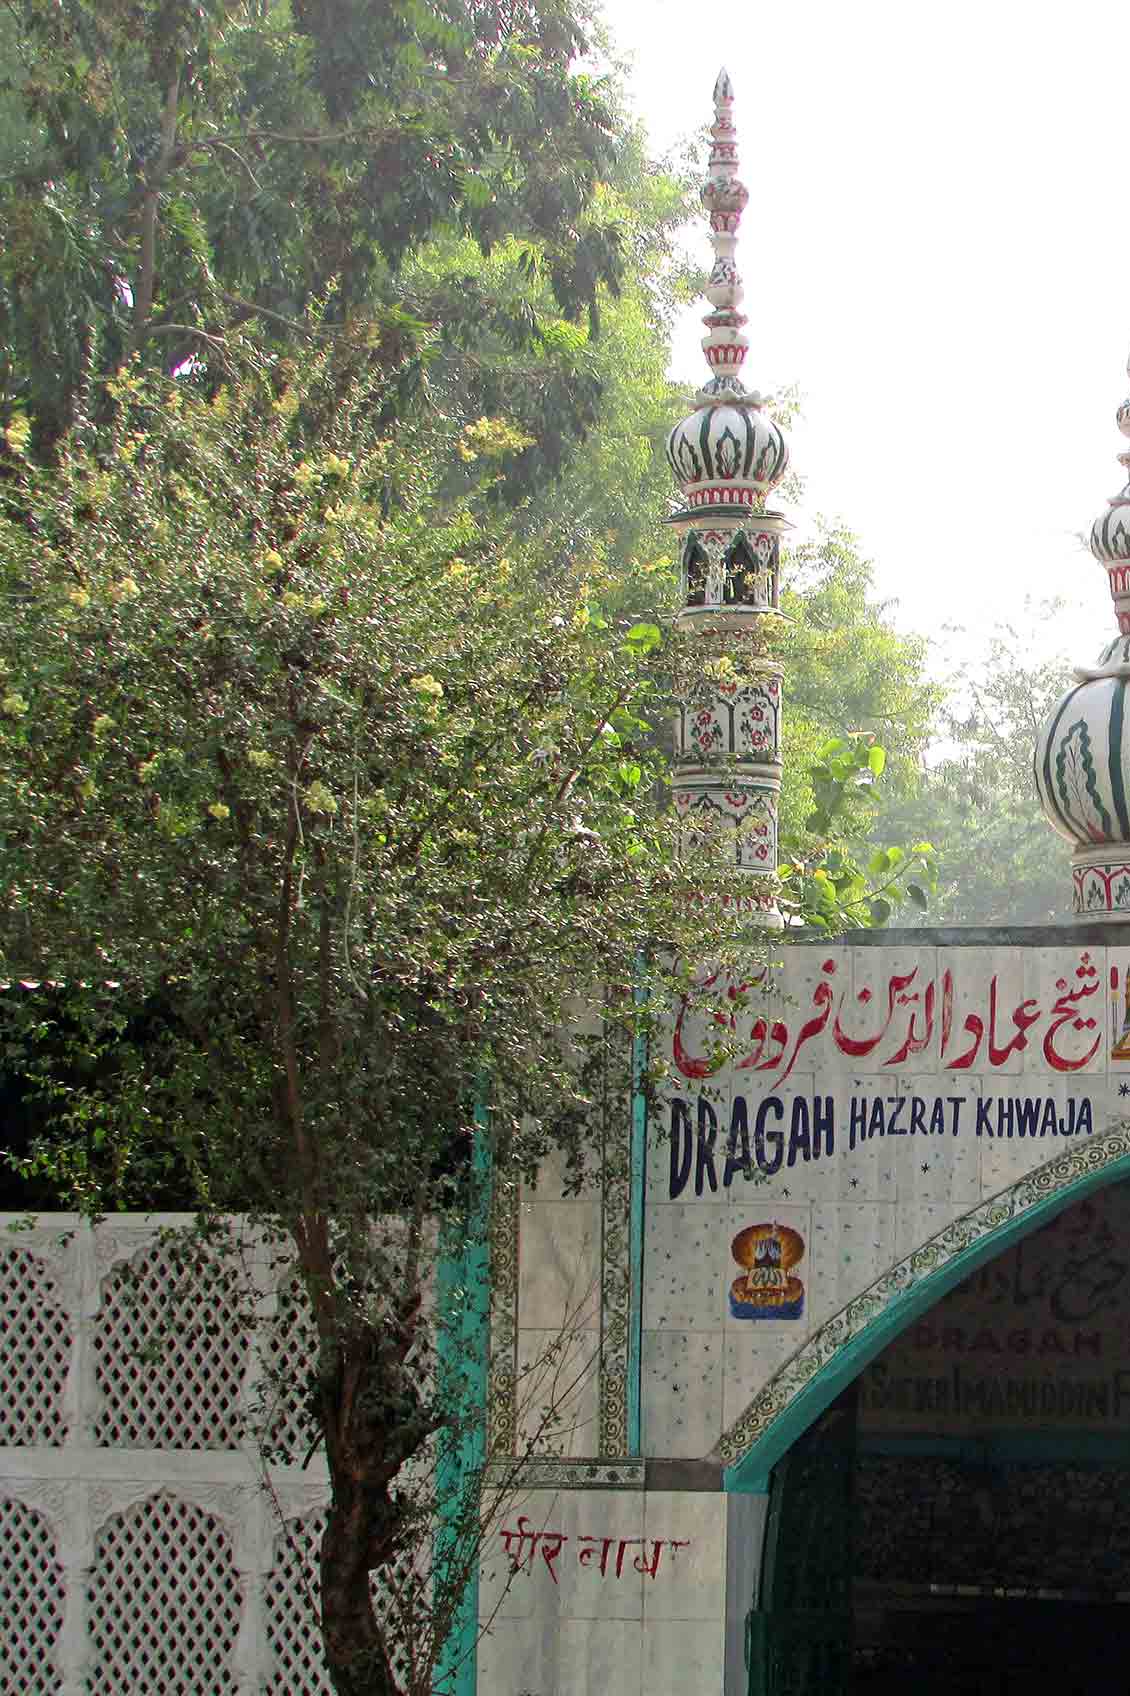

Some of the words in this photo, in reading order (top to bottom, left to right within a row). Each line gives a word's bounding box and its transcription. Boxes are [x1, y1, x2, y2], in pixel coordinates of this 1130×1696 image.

[669, 1095, 835, 1200] DRAGAH
[849, 1097, 967, 1151] HAZRAT
[976, 1097, 1094, 1138] KHWAJA
